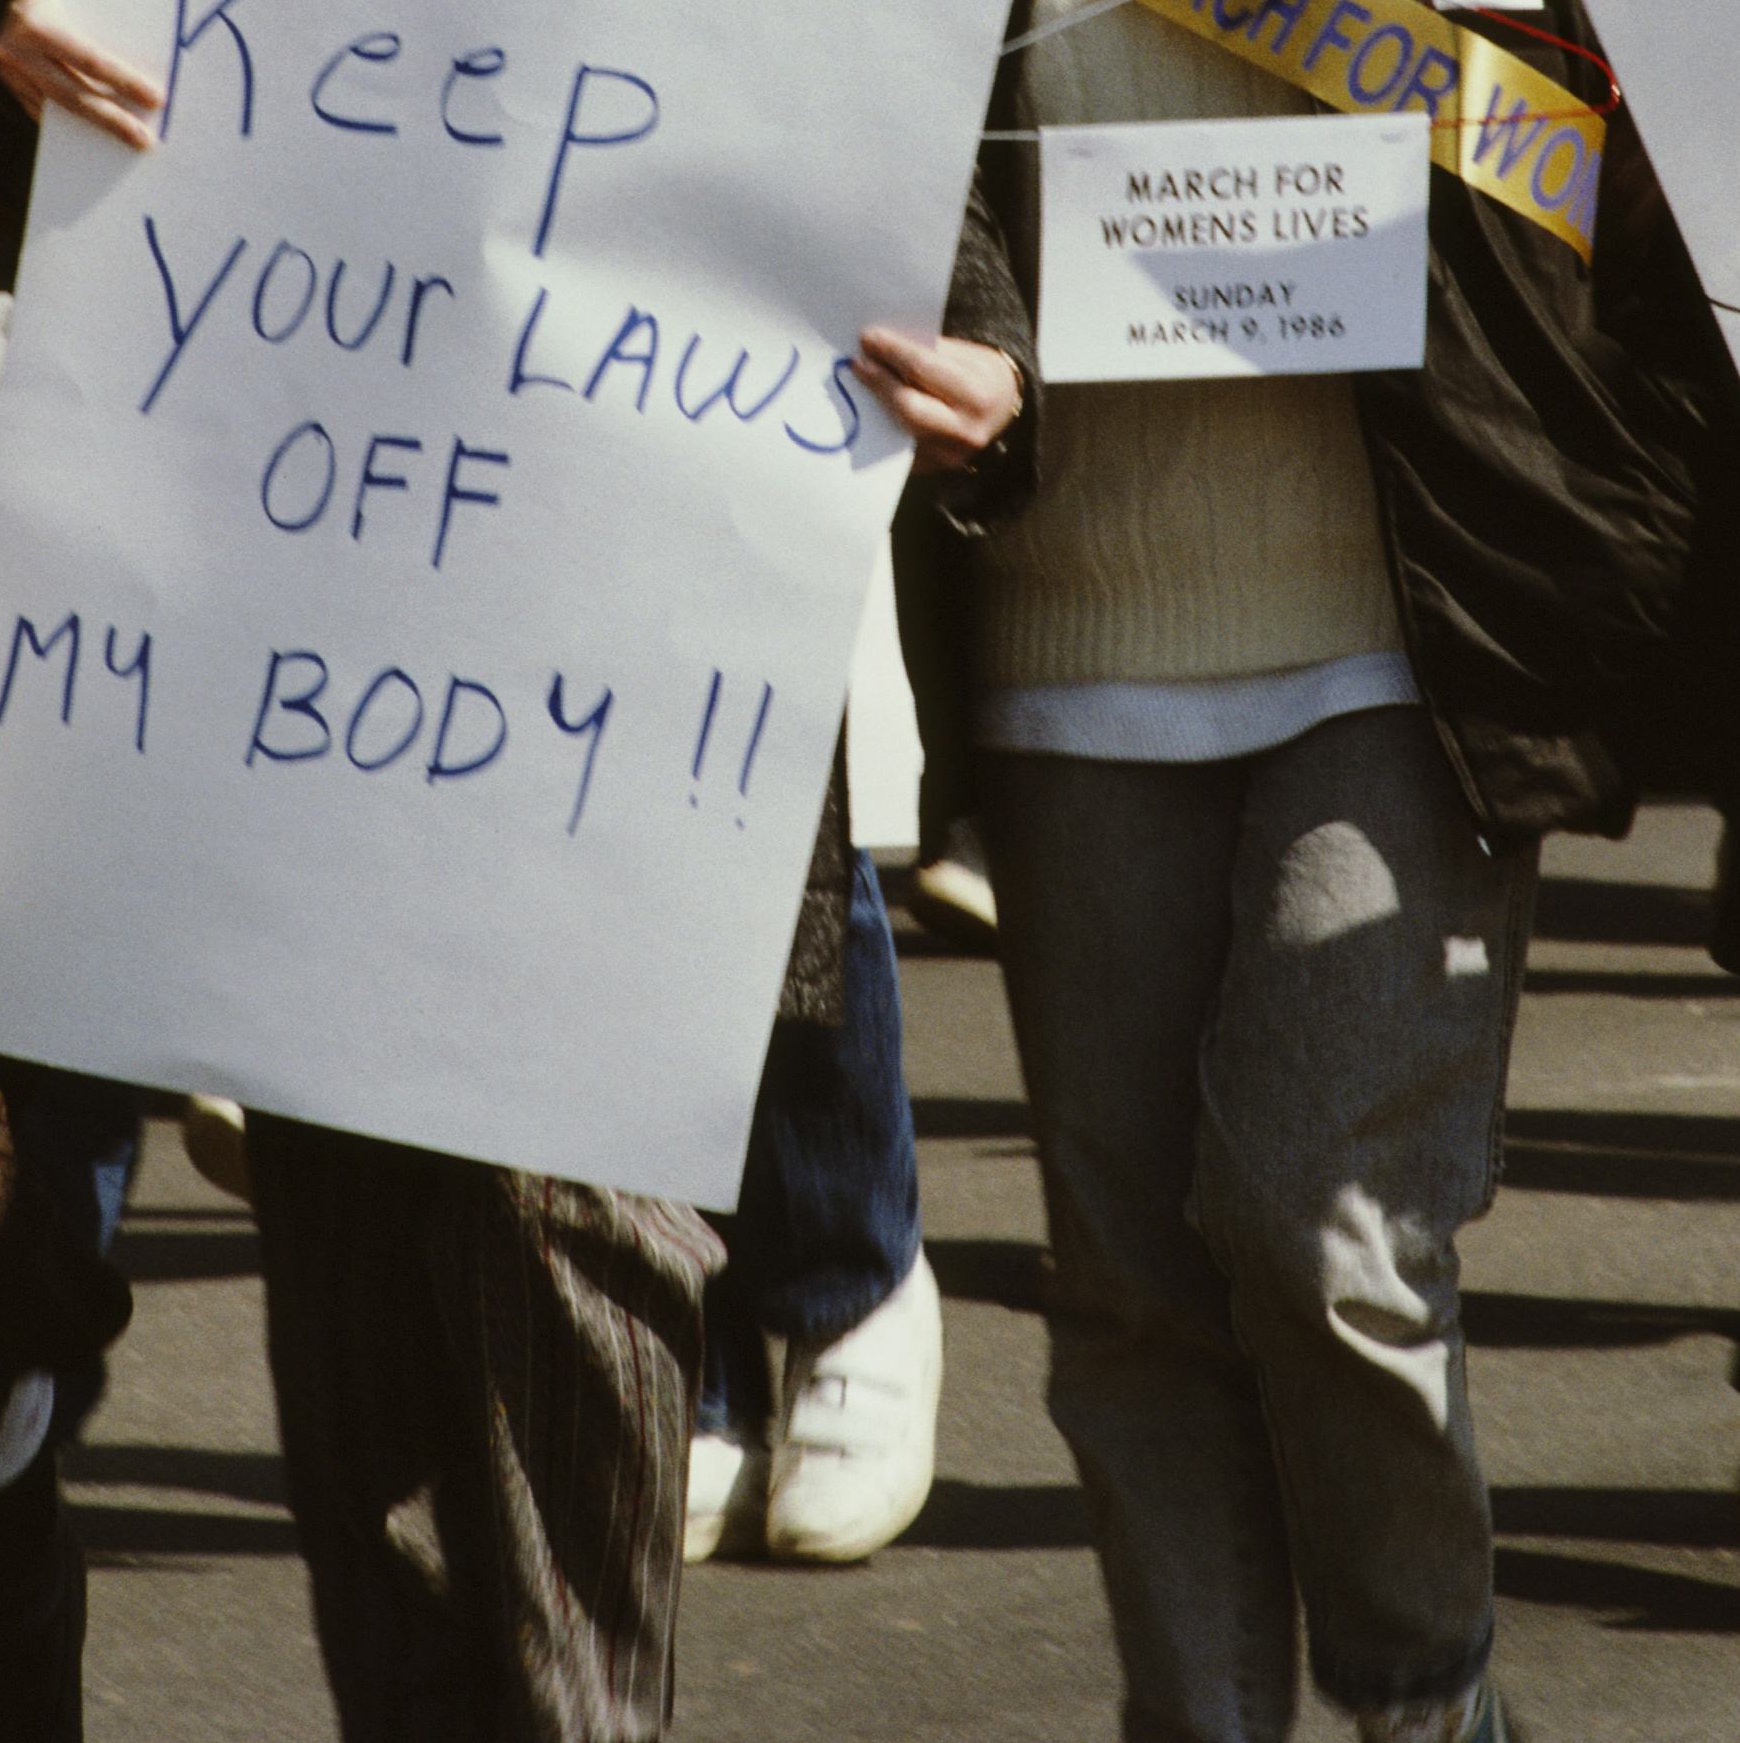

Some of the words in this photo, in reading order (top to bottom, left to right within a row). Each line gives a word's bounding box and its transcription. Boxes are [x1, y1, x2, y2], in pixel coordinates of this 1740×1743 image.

[1125, 165, 1259, 203] MARCH
[1274, 162, 1346, 198] FOR
[1100, 208, 1258, 249] WOMENS
[1272, 205, 1370, 244] LIVES
[1173, 279, 1297, 311] SUNDAY
[1126, 316, 1230, 345] MARCH
[1277, 310, 1348, 341] 1986
[509, 286, 863, 456] LAWS
[260, 420, 511, 569] OFF
[246, 648, 614, 836] BODY
